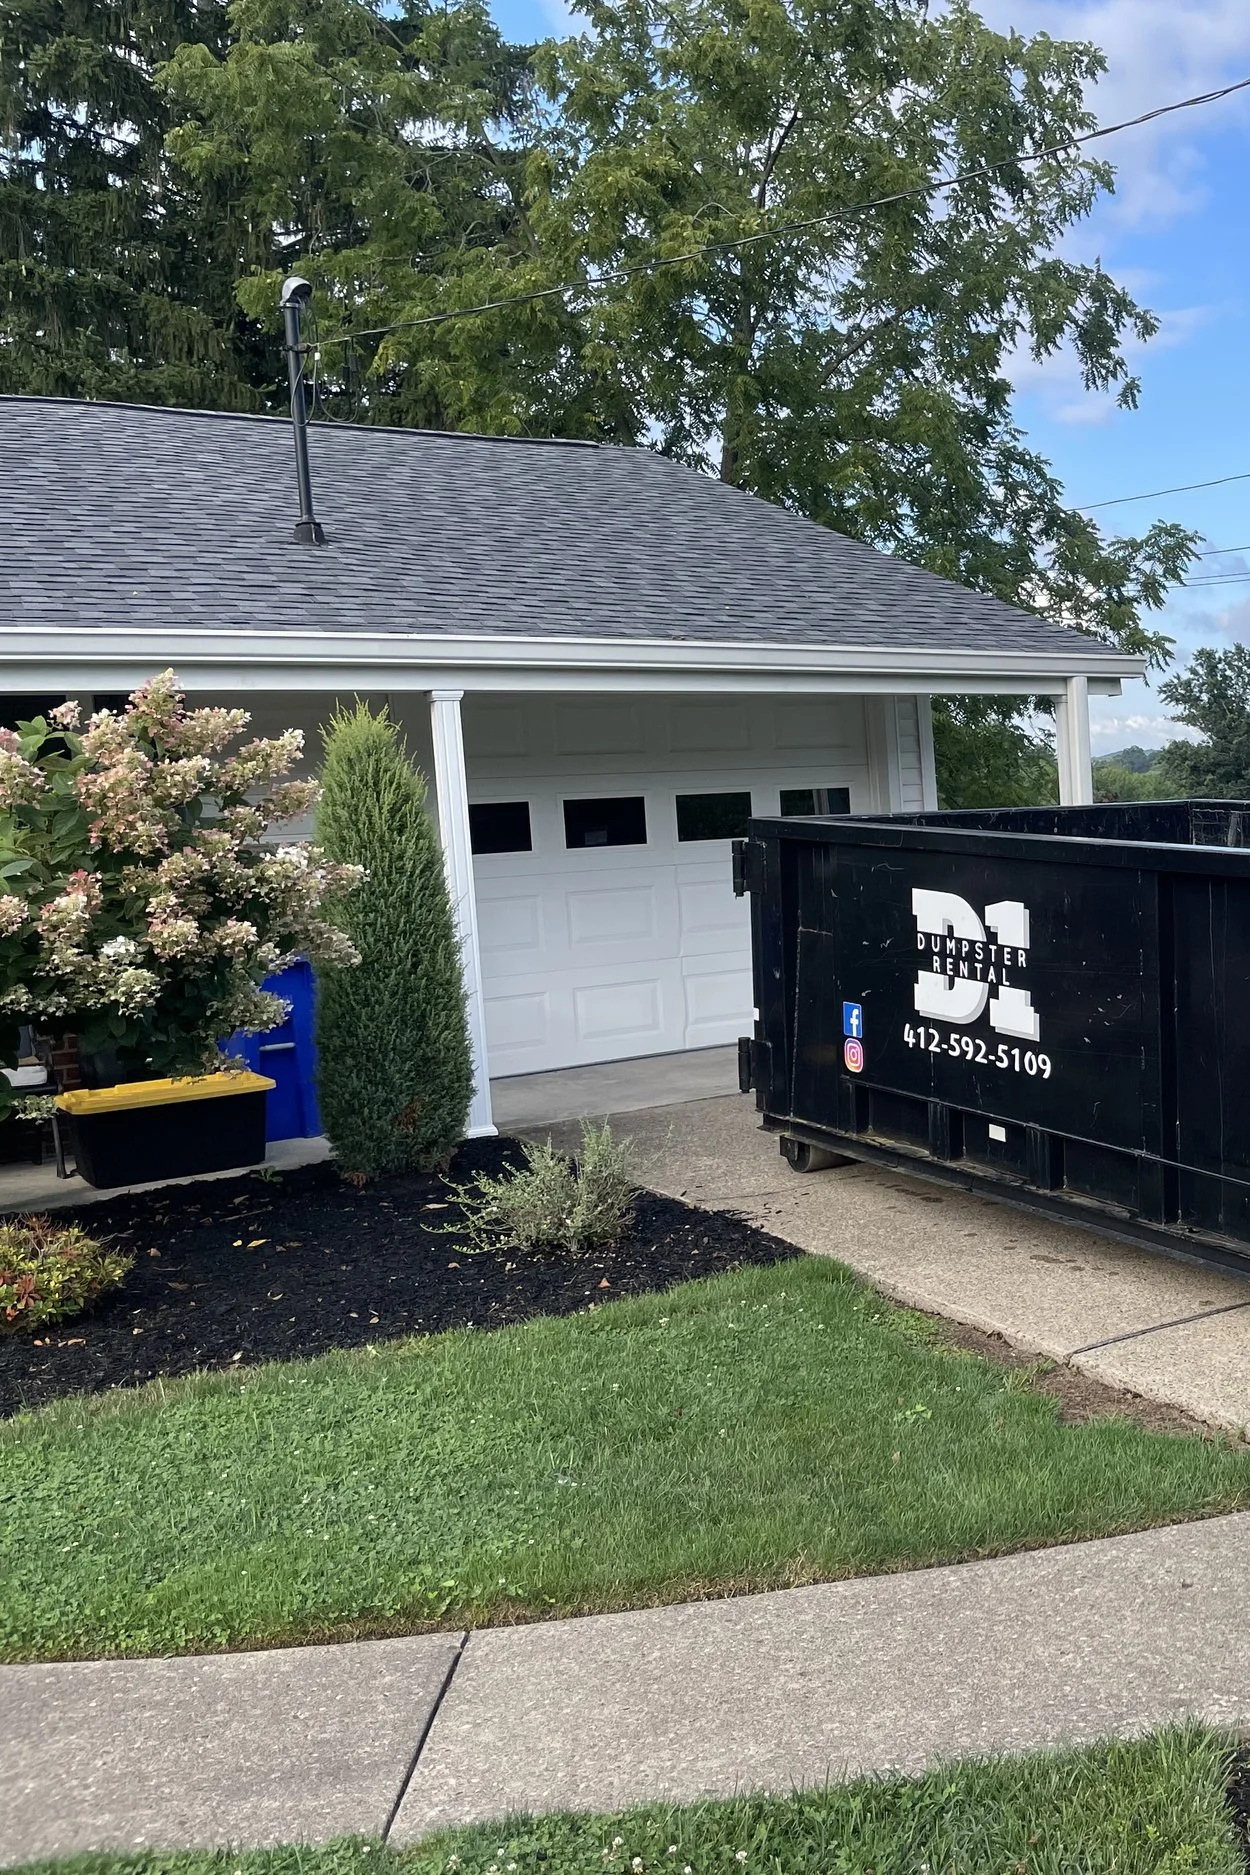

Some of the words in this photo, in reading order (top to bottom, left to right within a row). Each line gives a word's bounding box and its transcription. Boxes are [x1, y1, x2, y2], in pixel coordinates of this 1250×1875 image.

[917, 933, 1027, 968] DUMPSTER
[932, 955, 1010, 986] RENTAL
[903, 1023, 1052, 1080] 412-592-5109
